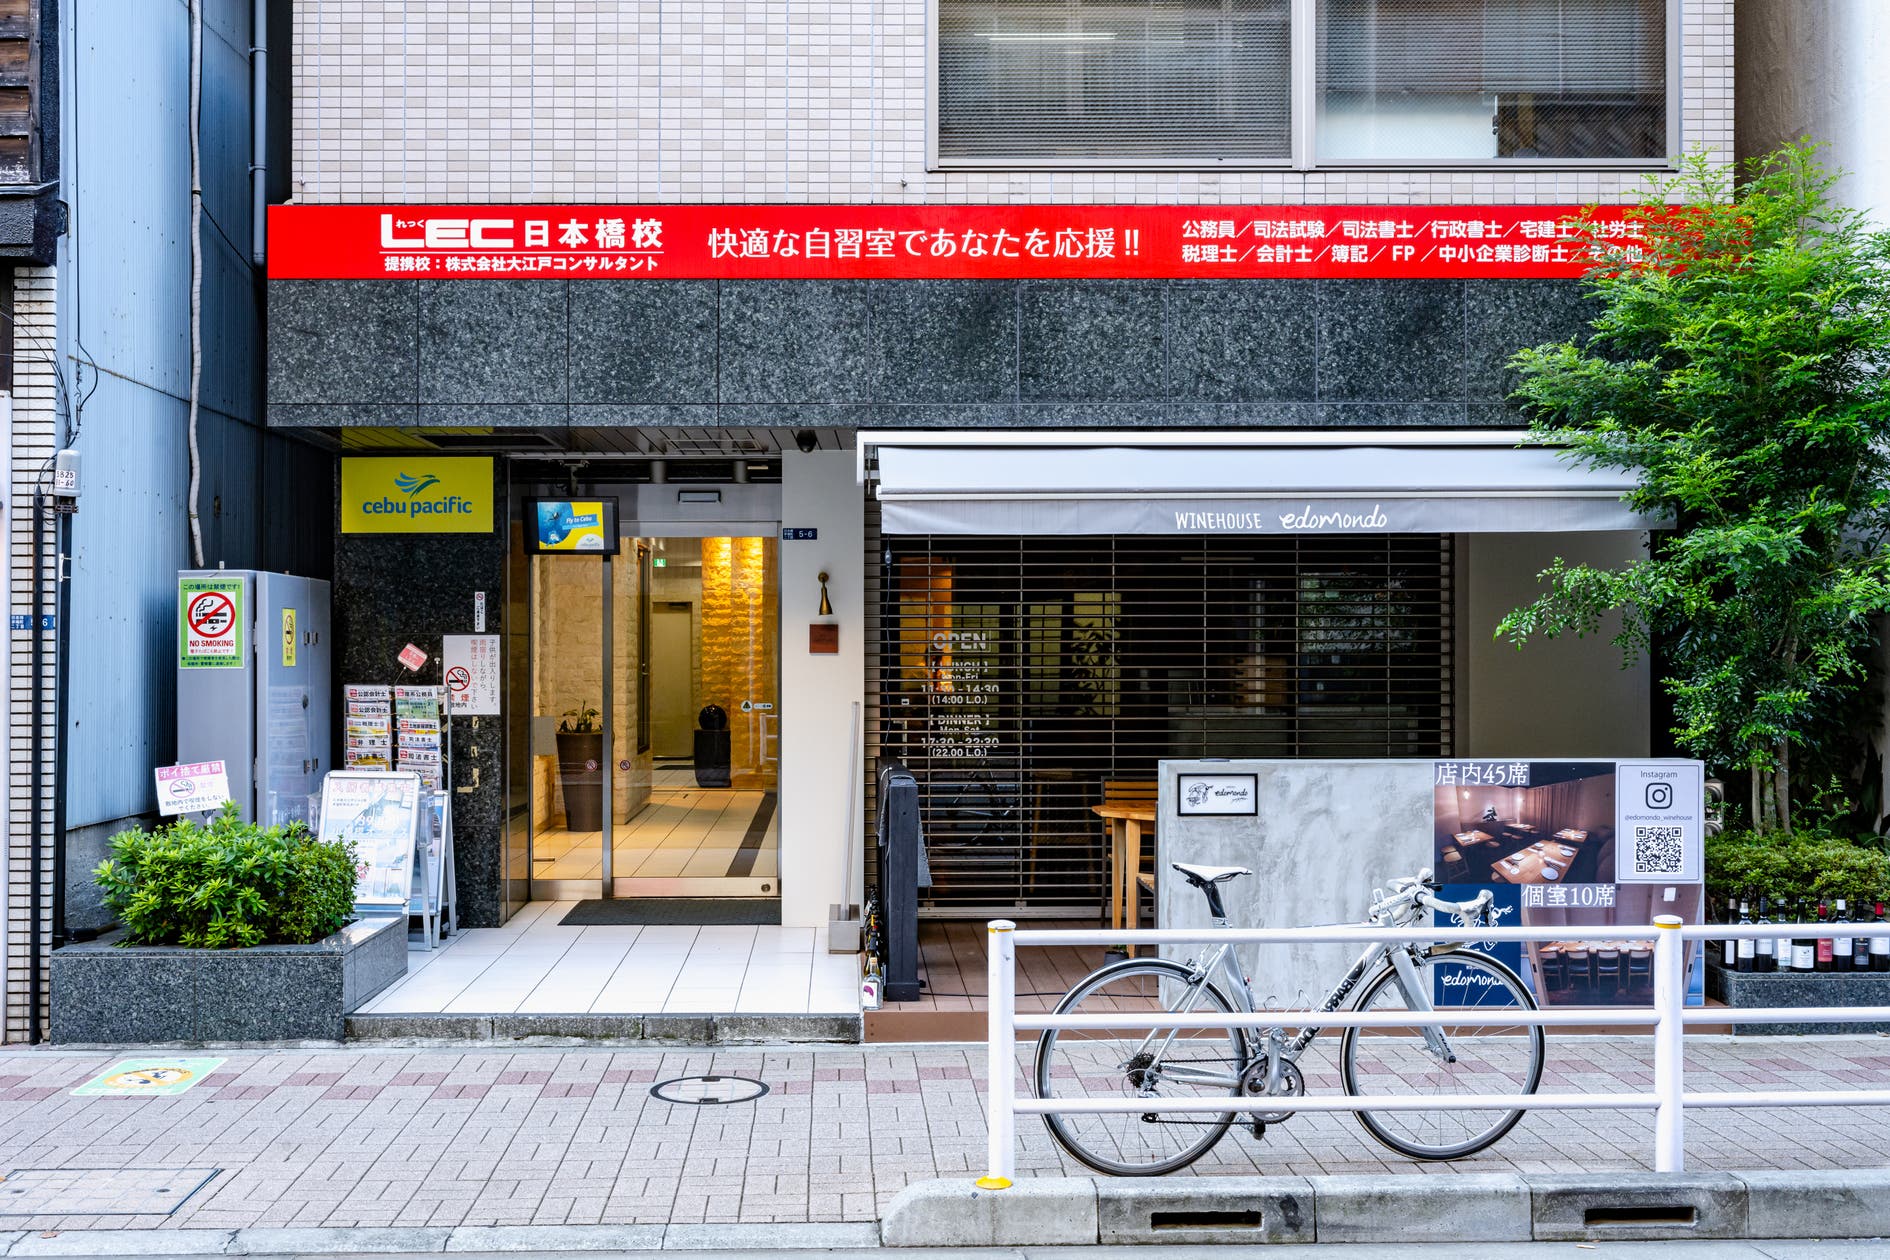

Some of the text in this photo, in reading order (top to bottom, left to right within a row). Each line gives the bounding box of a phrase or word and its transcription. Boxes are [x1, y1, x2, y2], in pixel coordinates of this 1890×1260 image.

[381, 214, 663, 249] LEC 日本橋校
[396, 219, 424, 228] れっく
[384, 255, 660, 272] 提携校：株式会社大江戸コンサルタント
[362, 496, 473, 518] cebu pacific
[1174, 504, 1388, 529] WINEHOUSE edomondo
[799, 530, 813, 538] 5-6
[933, 632, 987, 650] OPEN
[932, 695, 988, 705] (14:00 L.O.)
[938, 714, 982, 725] DINNER
[1435, 763, 1529, 785] 店内45席
[1640, 770, 1678, 779] Instagram
[1521, 884, 1615, 907] 個室10席
